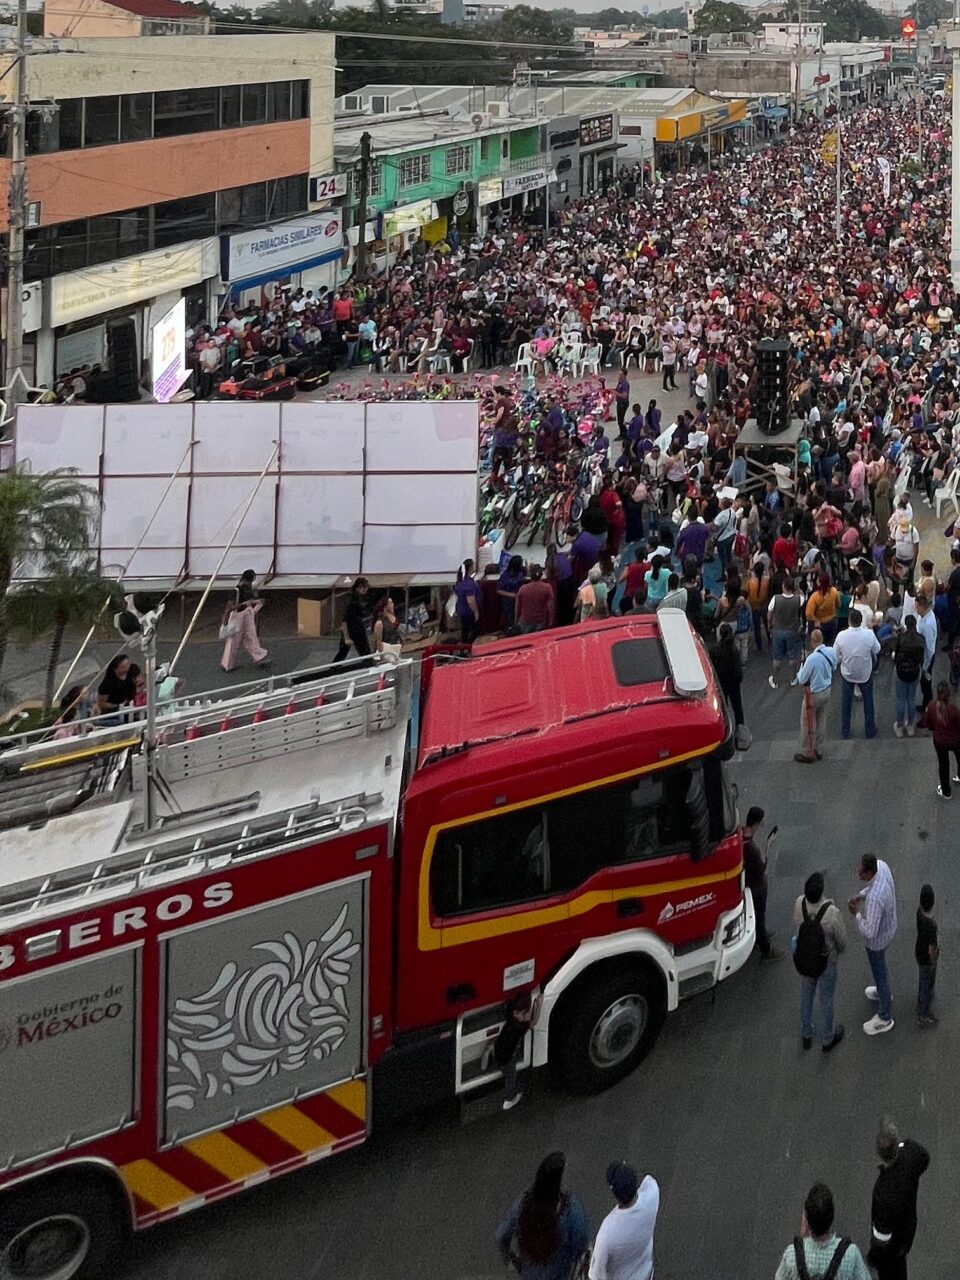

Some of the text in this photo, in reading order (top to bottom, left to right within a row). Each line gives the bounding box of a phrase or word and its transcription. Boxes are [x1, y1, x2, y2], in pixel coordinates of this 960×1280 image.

[320, 178, 336, 197] 24
[515, 171, 544, 186] FARMACIA
[250, 233, 288, 254] FARMACIAS
[289, 224, 322, 243] SIMILARES
[676, 892, 712, 913] PEMEX
[17, 984, 124, 1025] Gobierno de
[17, 1002, 122, 1049] México
